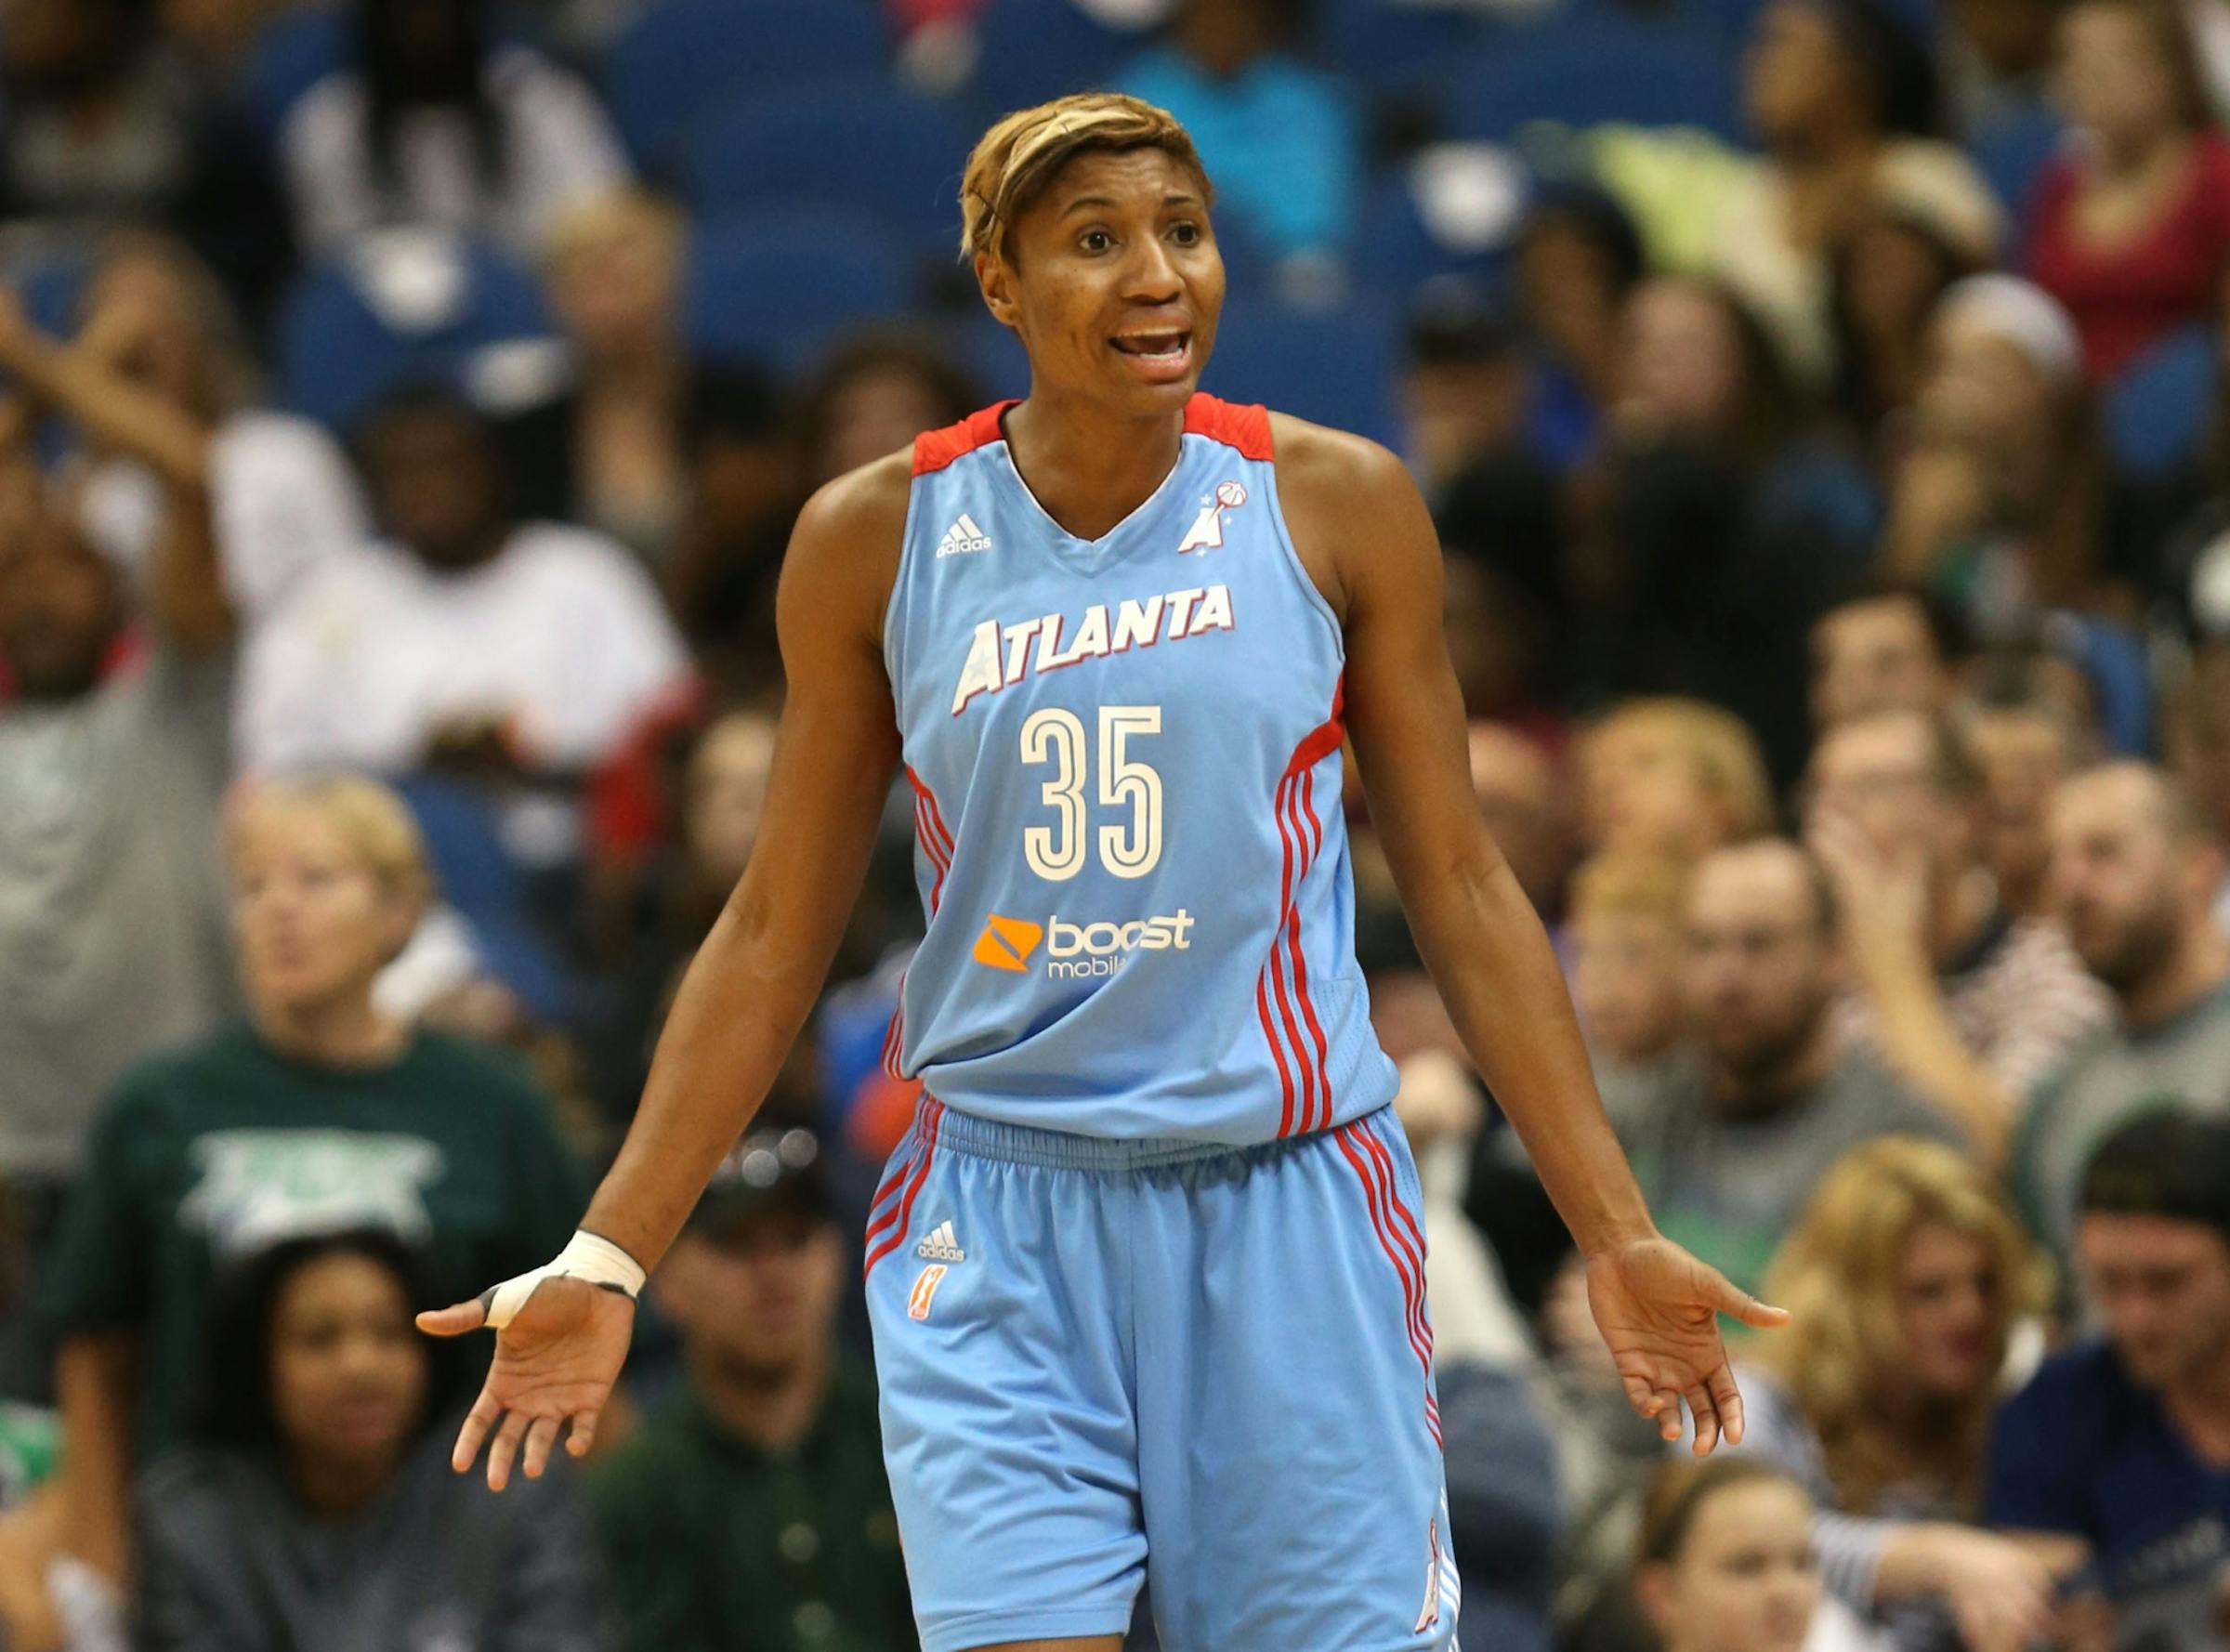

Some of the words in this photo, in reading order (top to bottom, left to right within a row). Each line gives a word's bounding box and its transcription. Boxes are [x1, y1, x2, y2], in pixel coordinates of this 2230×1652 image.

[936, 536, 991, 557] adidas
[950, 584, 1234, 716] ATLANTA
[1020, 705, 1162, 882] 35
[1048, 909, 1193, 956] boost
[917, 1244, 965, 1263] adidas
